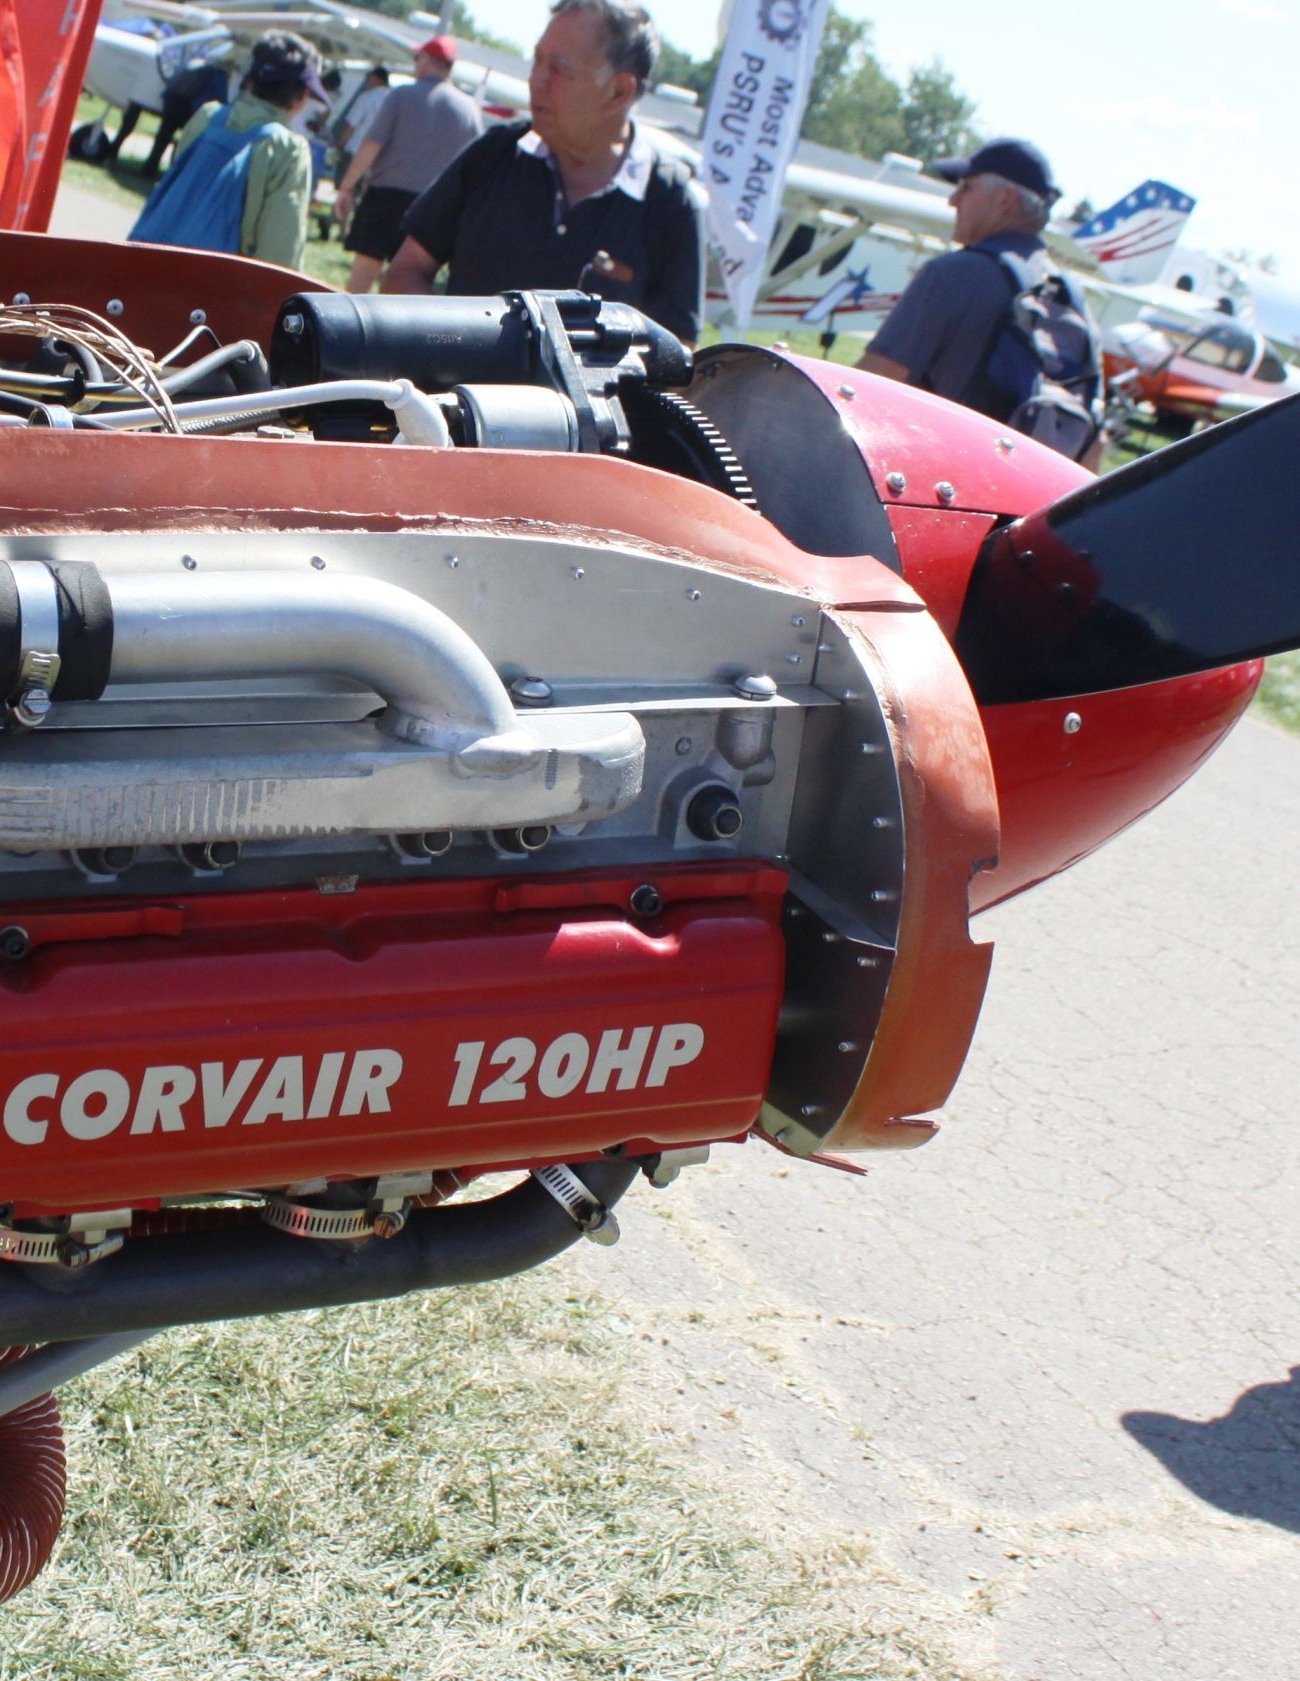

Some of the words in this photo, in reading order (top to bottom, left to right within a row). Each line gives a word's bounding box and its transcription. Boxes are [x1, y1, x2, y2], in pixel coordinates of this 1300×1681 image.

[712, 51, 766, 157] PSRU's
[756, 75, 794, 148] Most
[2, 1048, 403, 1145] CORVAIR
[447, 1022, 705, 1107] 120HP
